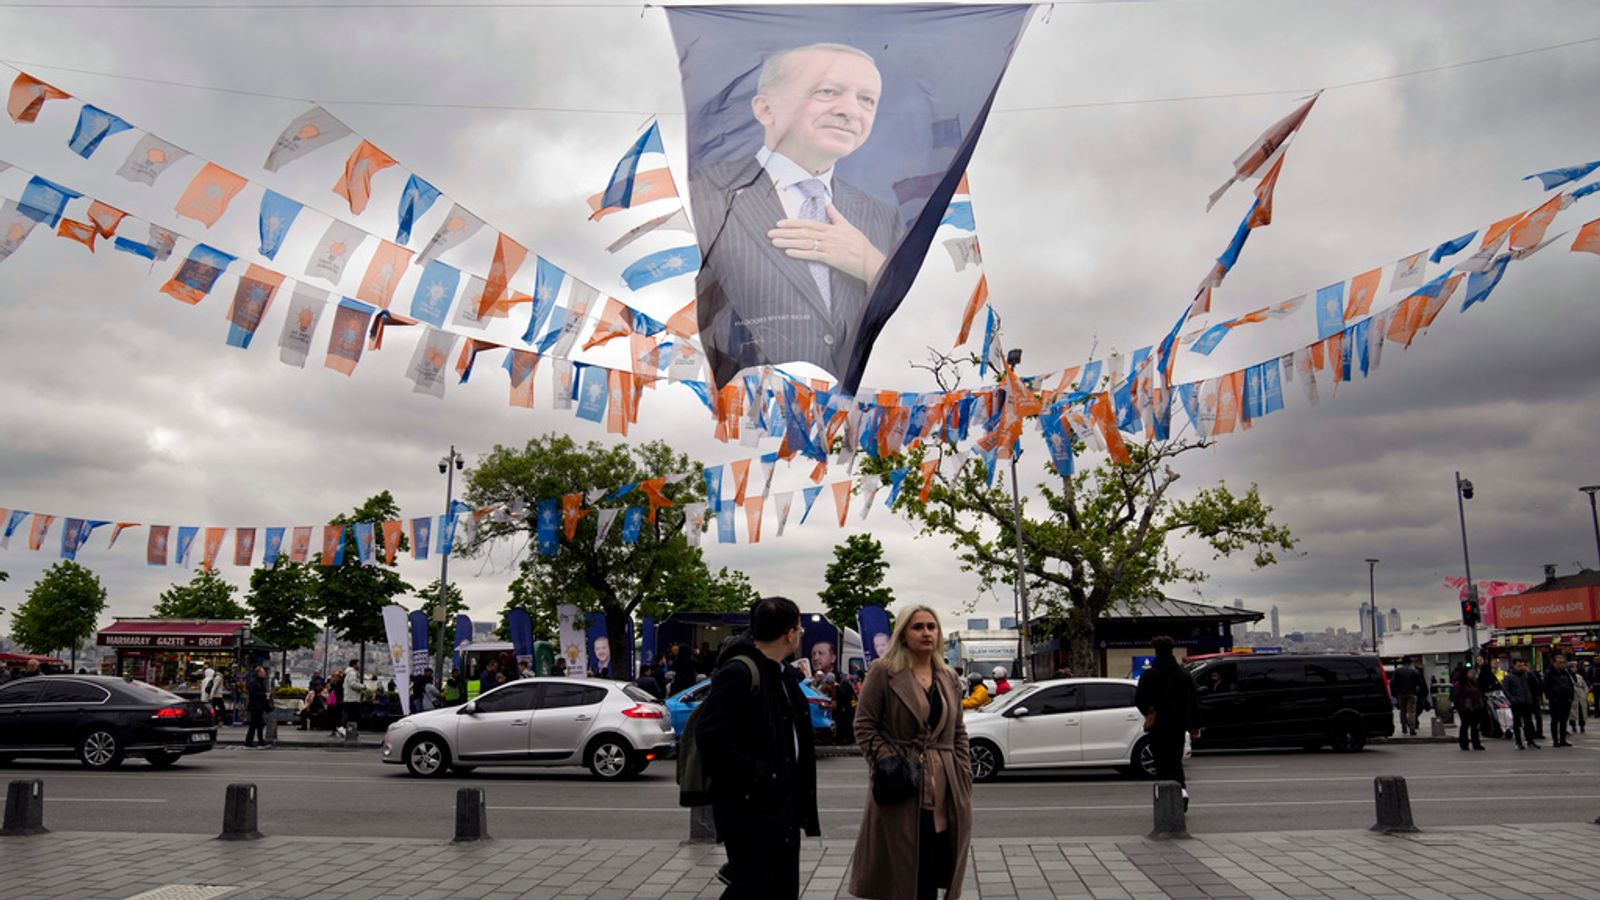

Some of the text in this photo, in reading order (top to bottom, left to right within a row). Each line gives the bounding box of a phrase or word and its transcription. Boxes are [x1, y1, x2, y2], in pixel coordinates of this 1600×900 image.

[106, 636, 151, 645] MARMARAY
[156, 637, 185, 646] GAZETE
[198, 636, 222, 647] DERGİ
